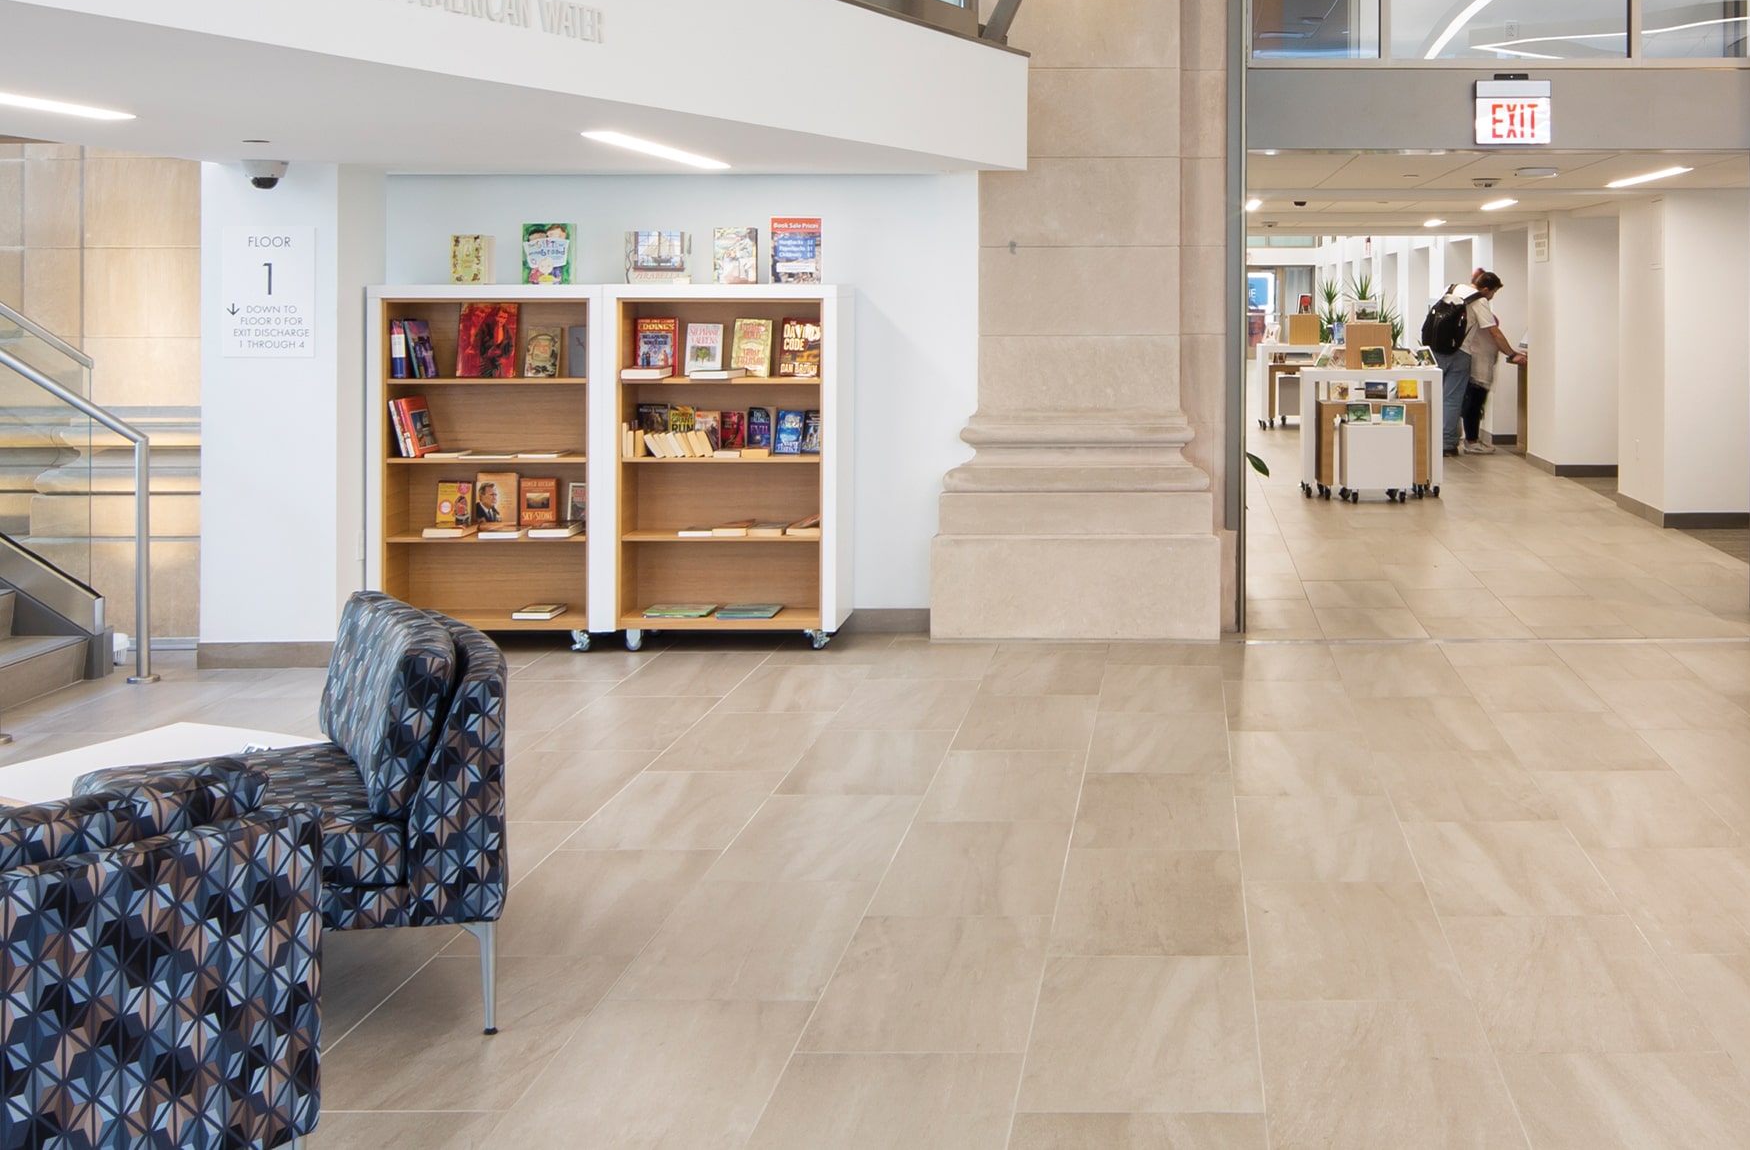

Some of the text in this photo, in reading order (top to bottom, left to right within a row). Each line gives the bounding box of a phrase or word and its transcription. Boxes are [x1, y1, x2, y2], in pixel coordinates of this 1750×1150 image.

[1491, 103, 1539, 139] EXIT
[248, 236, 291, 248] FLOOR
[263, 263, 272, 296] 1
[246, 306, 298, 314] DOWN TO
[240, 317, 272, 326] FLOOR
[284, 317, 303, 326] FOR
[234, 329, 310, 338] EXIT DISCHARGE
[784, 324, 796, 338] DA
[248, 340, 296, 349] THROUGH
[299, 340, 305, 348] 4
[784, 338, 805, 350] CODE
[780, 363, 818, 374] DAN BROWN
